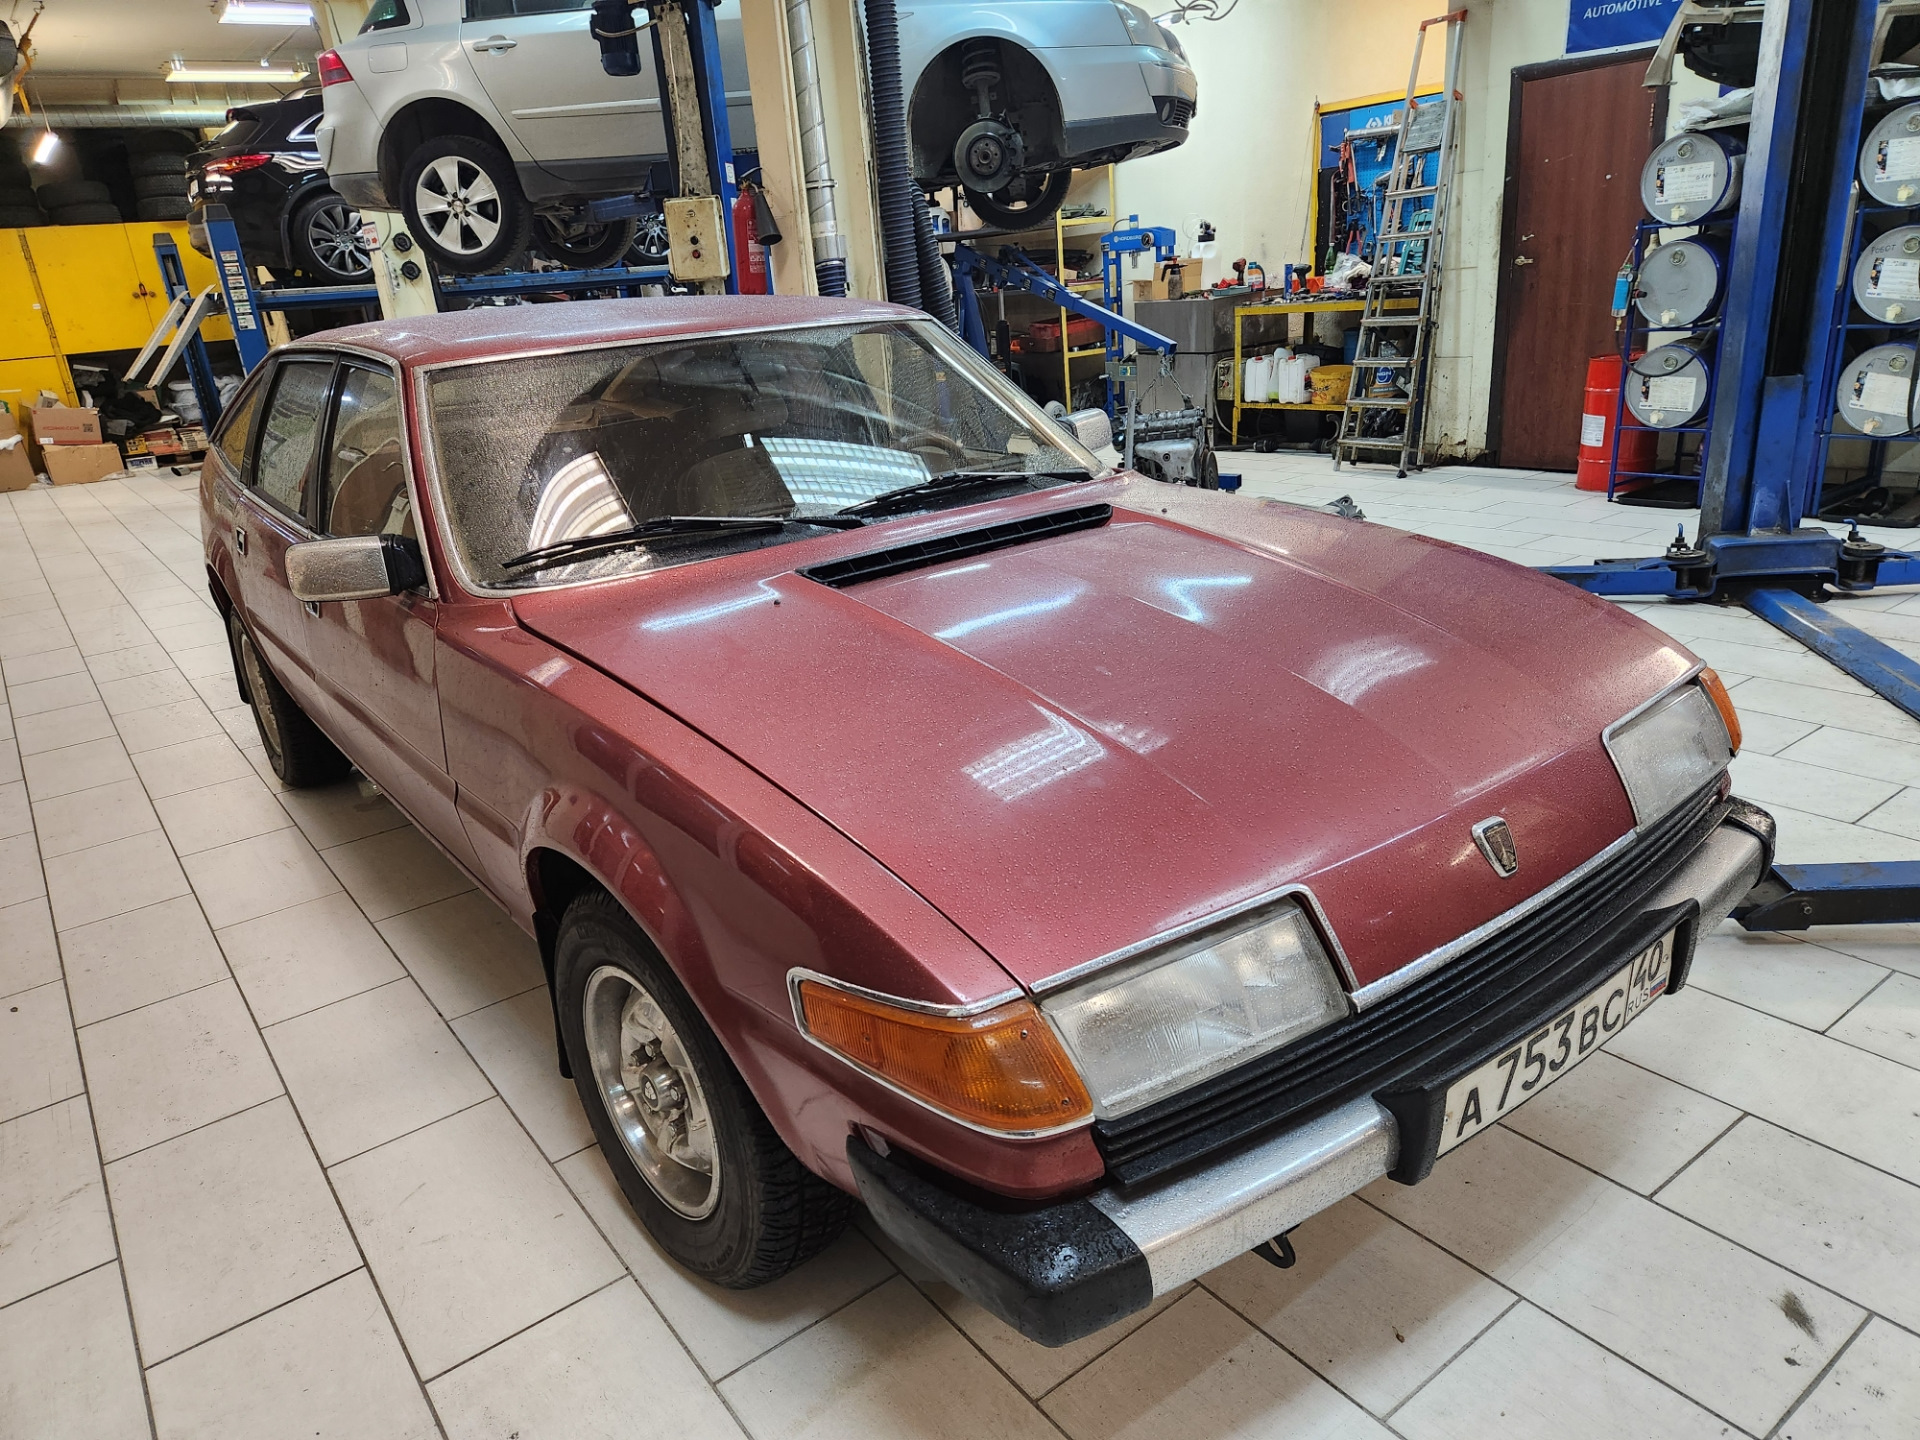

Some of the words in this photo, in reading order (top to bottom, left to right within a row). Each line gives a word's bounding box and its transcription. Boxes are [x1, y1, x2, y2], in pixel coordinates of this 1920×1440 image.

[1583, 0, 1663, 19] AUTOMOTIVE
[1633, 939, 1664, 991] 40
[1626, 987, 1649, 1018] RUS
